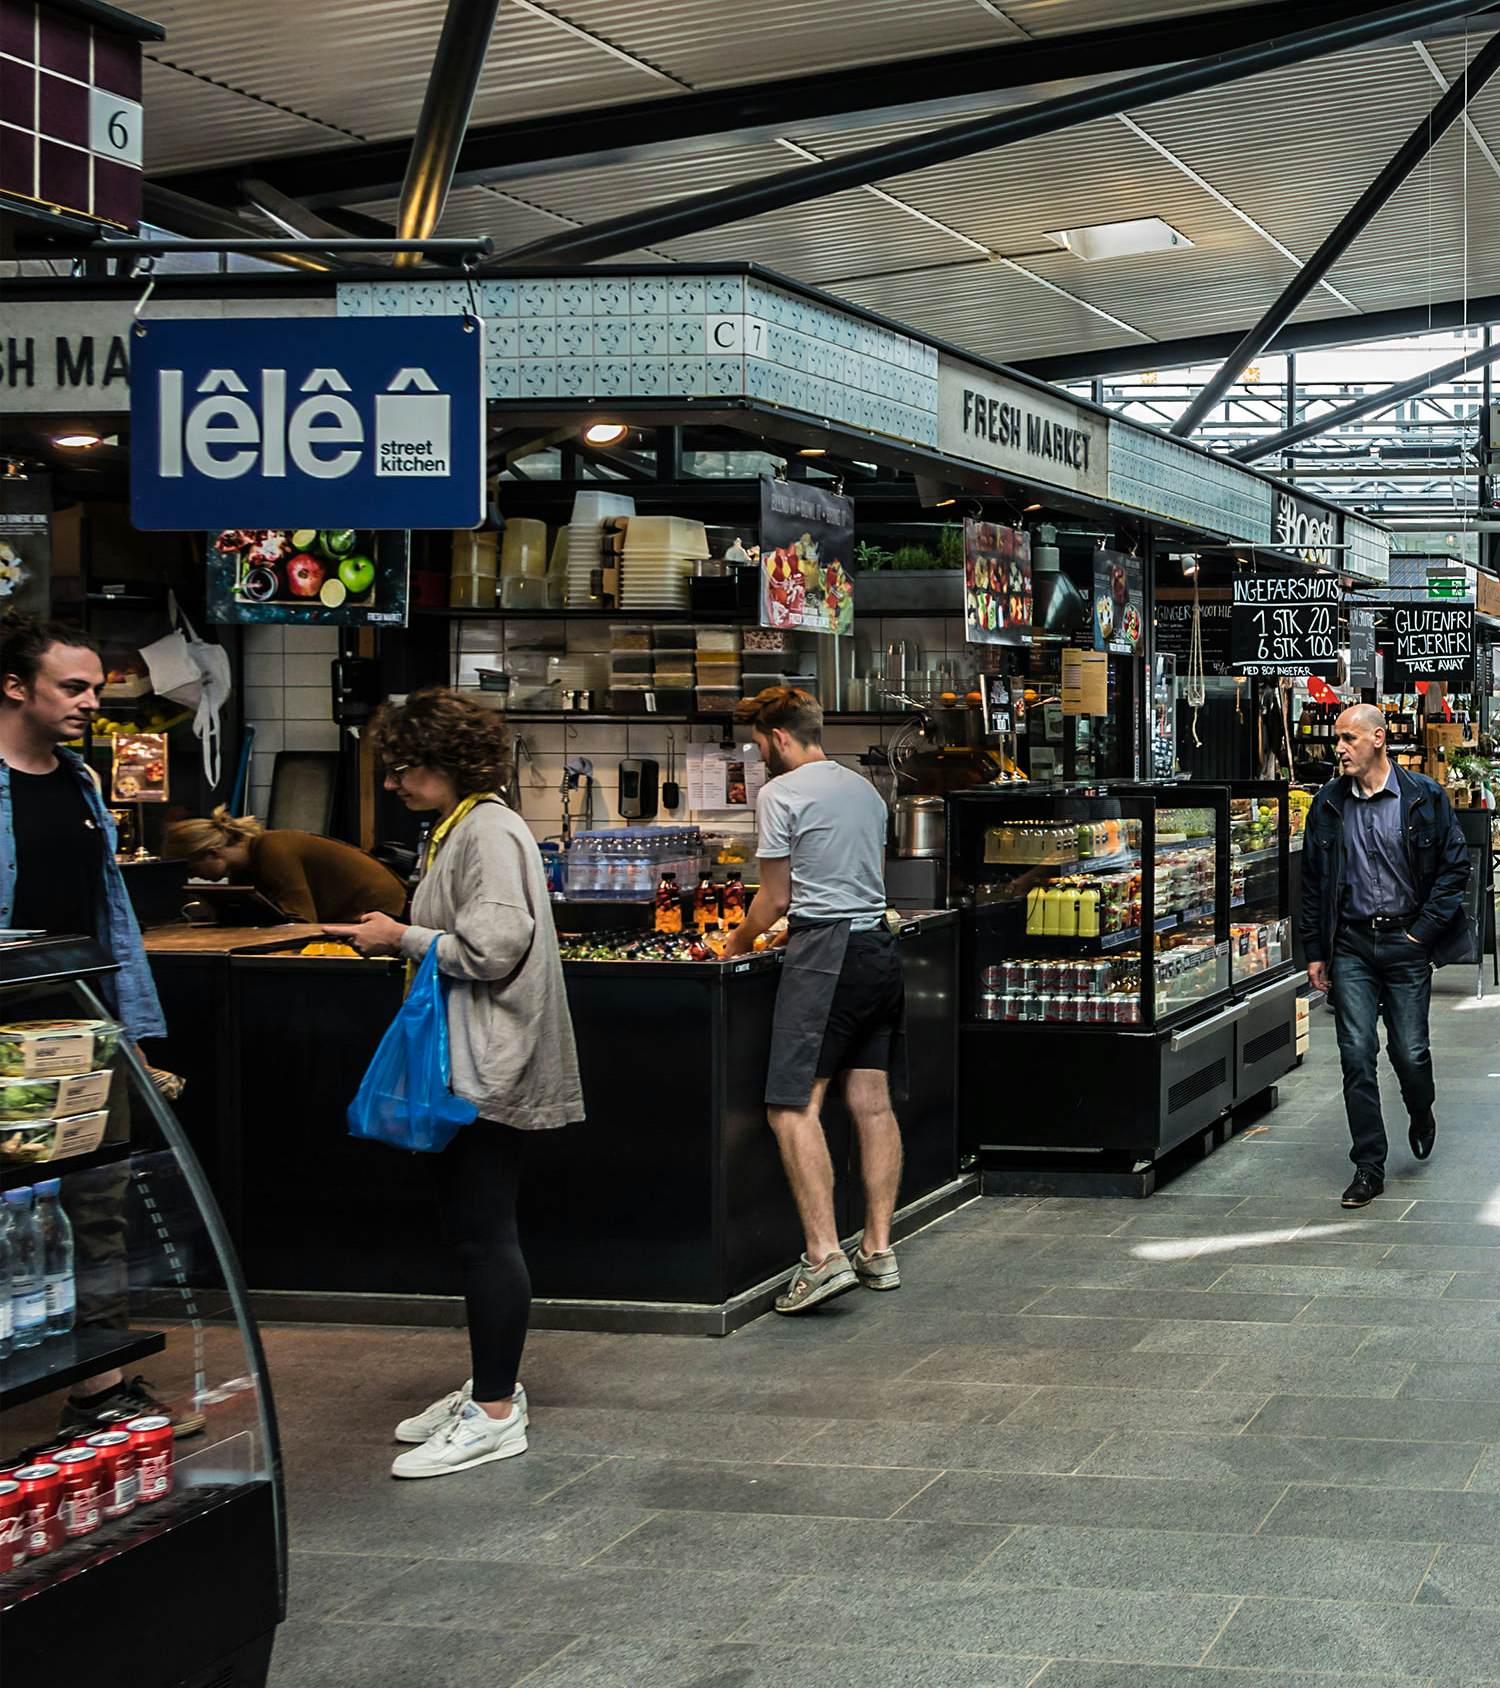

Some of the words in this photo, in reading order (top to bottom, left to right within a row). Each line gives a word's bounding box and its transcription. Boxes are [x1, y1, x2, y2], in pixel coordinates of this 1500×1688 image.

[107, 110, 129, 150] 6
[714, 321, 736, 348] C
[752, 324, 762, 352] 7
[159, 368, 365, 480] lêlê
[963, 389, 1021, 450] FRESH
[1027, 412, 1092, 473] MARKET
[380, 440, 433, 456] street
[380, 456, 446, 472] kitchen
[1233, 577, 1339, 601] INGEFÆRSHOTS
[1157, 605, 1192, 621] GINGER
[1252, 609, 1268, 637] 1
[1273, 608, 1304, 636] STK
[1308, 607, 1337, 635] 20,-
[1395, 609, 1472, 634] GLUTENFRI
[1257, 638, 1270, 660] 6
[1273, 637, 1304, 660] STK
[1305, 635, 1339, 657] 100,-
[1398, 632, 1472, 657] MEJERIFRI
[1242, 667, 1259, 676] MED
[1277, 666, 1316, 677] INGEFÆR
[1405, 660, 1436, 673] TAKE
[1438, 658, 1464, 671] AWAY
